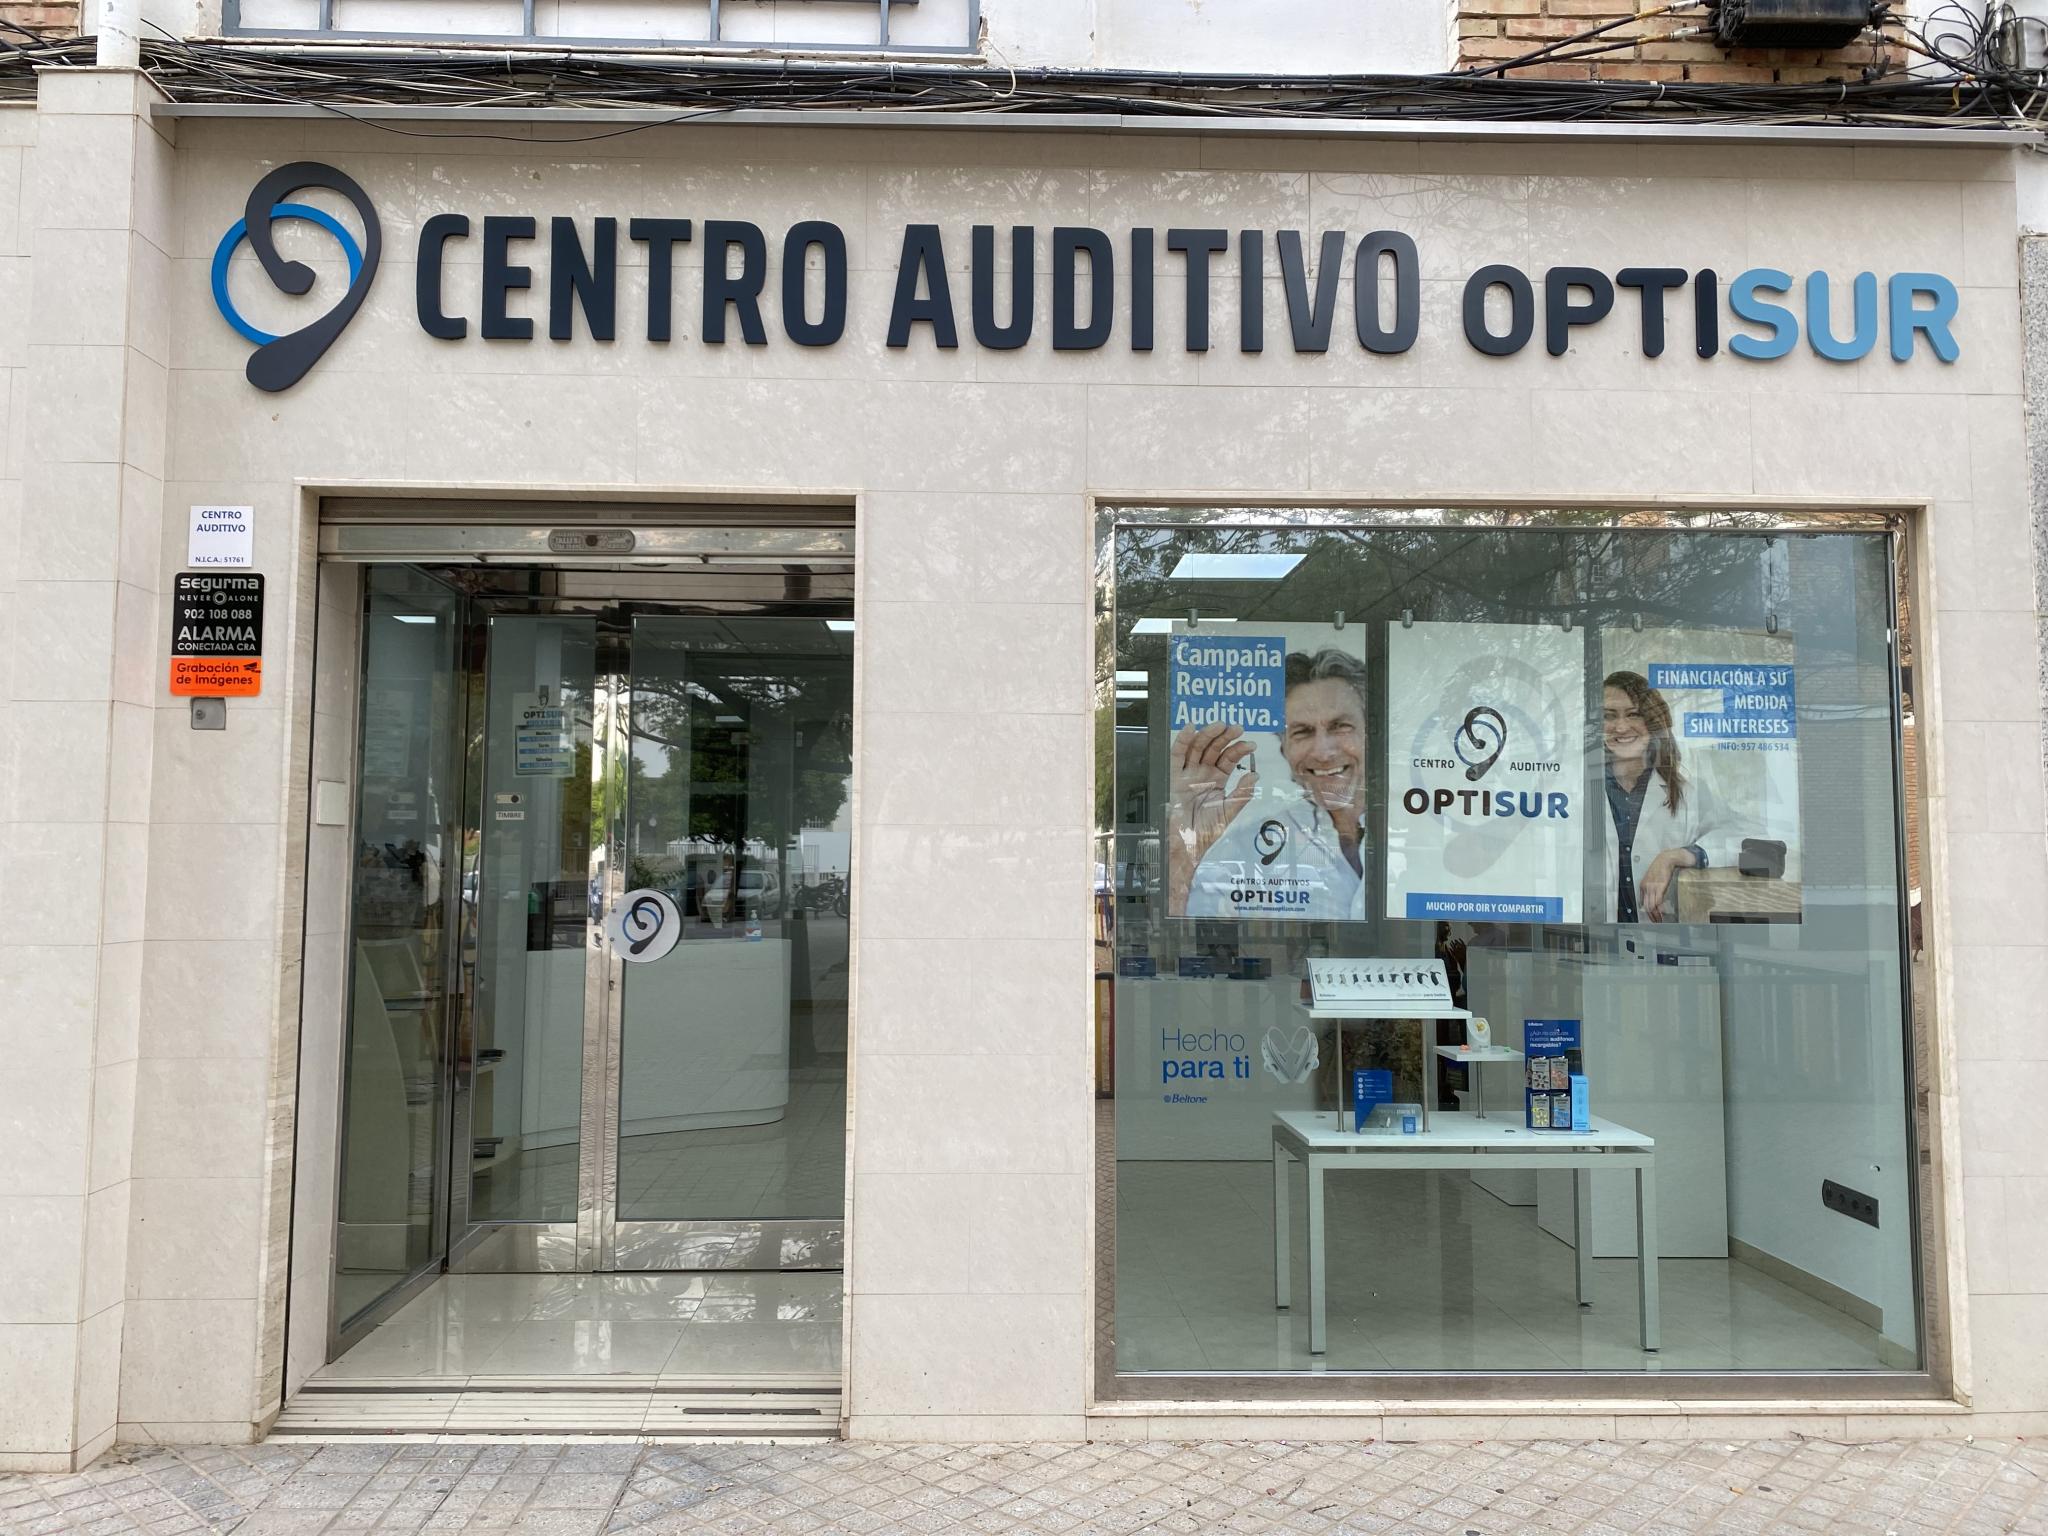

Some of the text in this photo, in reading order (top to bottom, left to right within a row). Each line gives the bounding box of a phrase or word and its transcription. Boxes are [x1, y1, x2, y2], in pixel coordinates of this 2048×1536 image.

[415, 213, 1962, 364] CENTRO AUDITIVO OPTISUR
[201, 510, 242, 519] CENTRO
[196, 524, 246, 533] AUDITIVO
[179, 577, 260, 592] segurma
[179, 594, 211, 602] NEVER
[183, 609, 253, 619] 902 108 088
[178, 626, 256, 641] ALARMA
[177, 642, 256, 651] CONECTADA CRA
[1176, 642, 1282, 672] Campaña
[176, 662, 239, 673] Grabación
[176, 674, 192, 685] de
[1656, 667, 1788, 685] FINANCIACIÓN A SU
[1176, 672, 1272, 697] Revisión
[1734, 695, 1789, 710] MEDIDA
[1175, 701, 1279, 727] Auditiva.
[1690, 718, 1789, 734] SIN INTERESES
[1717, 742, 1740, 751] INFO:
[1741, 742, 1755, 751] 957
[1757, 742, 1772, 751] 486
[1774, 743, 1790, 751] 534
[1413, 758, 1561, 772] CENTRO AUDITIVO
[1403, 787, 1570, 819] OPTISUR
[1230, 877, 1310, 886] CENTROS AUDITIVOS
[1230, 889, 1311, 904] OPTISUR
[1425, 901, 1545, 915] MUCHO POR OIR Y COMPARTIR
[1161, 1027, 1246, 1053] Hecho
[1162, 1055, 1251, 1084] para ti
[1172, 1093, 1208, 1104] Beltone
